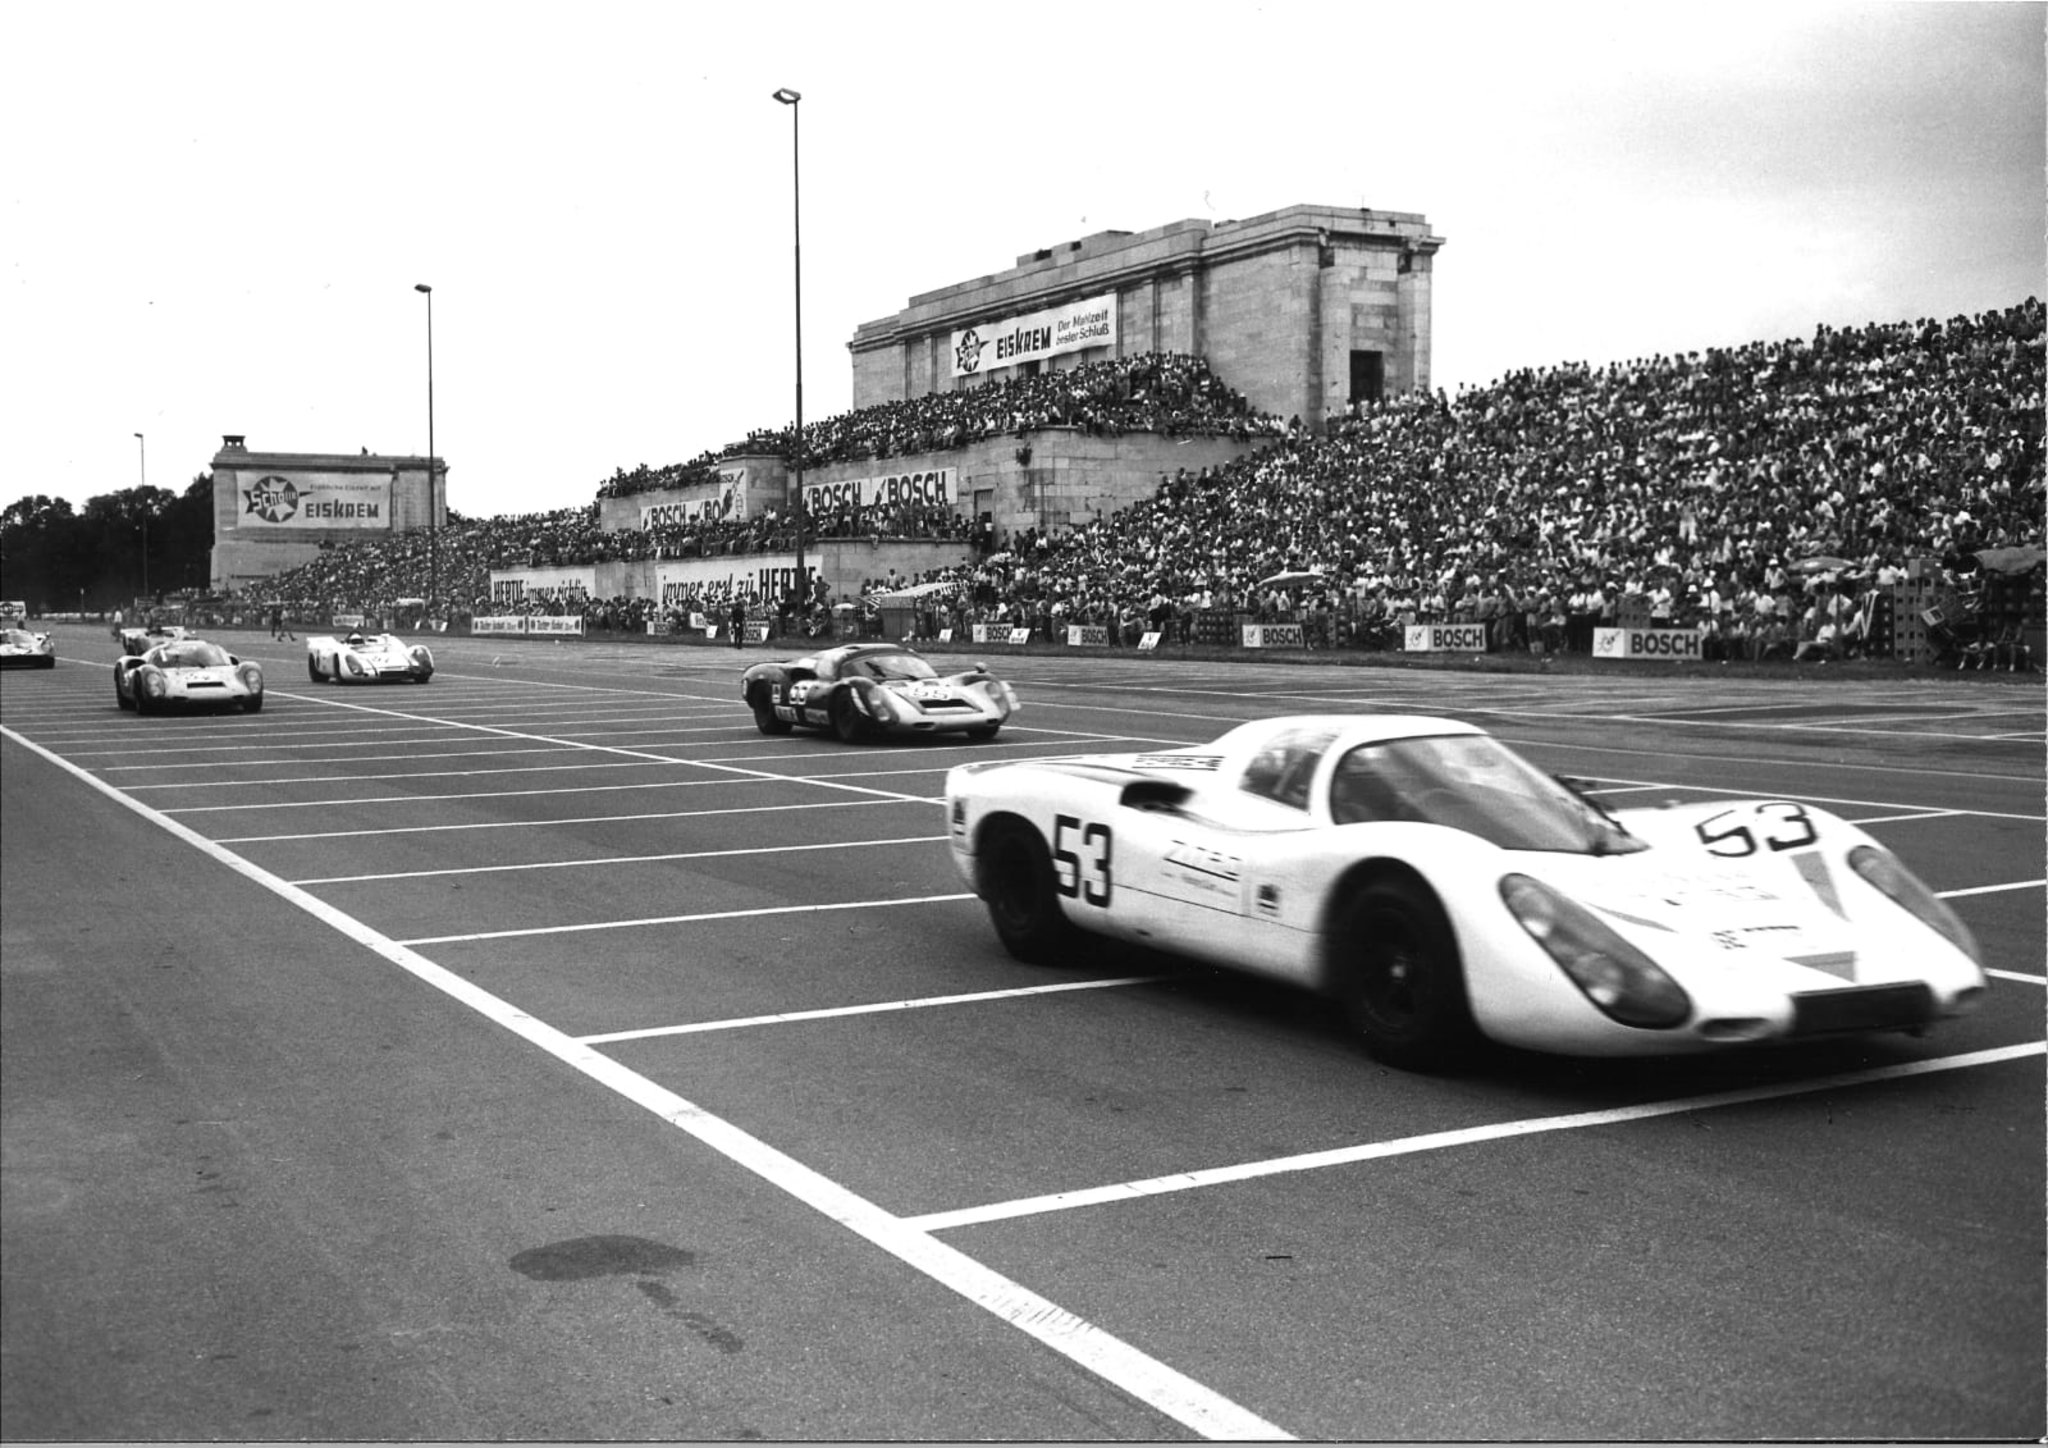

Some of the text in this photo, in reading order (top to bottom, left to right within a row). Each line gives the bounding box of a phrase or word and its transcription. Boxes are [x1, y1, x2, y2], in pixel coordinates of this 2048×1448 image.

[1058, 320, 1071, 332] Der
[1079, 322, 1110, 340] Schluß
[812, 481, 862, 512] BOSCH
[887, 470, 947, 506] BOSCH
[651, 503, 686, 528] BOSCH
[662, 575, 704, 604] immer
[986, 626, 1013, 640] BOSCH
[1082, 627, 1107, 645] BOSCH
[1263, 628, 1302, 644] BOSCH
[1433, 628, 1483, 648] BOSCH
[1630, 633, 1699, 656] BOSCH
[1694, 802, 1818, 858] 53
[1054, 813, 1113, 908] 53
